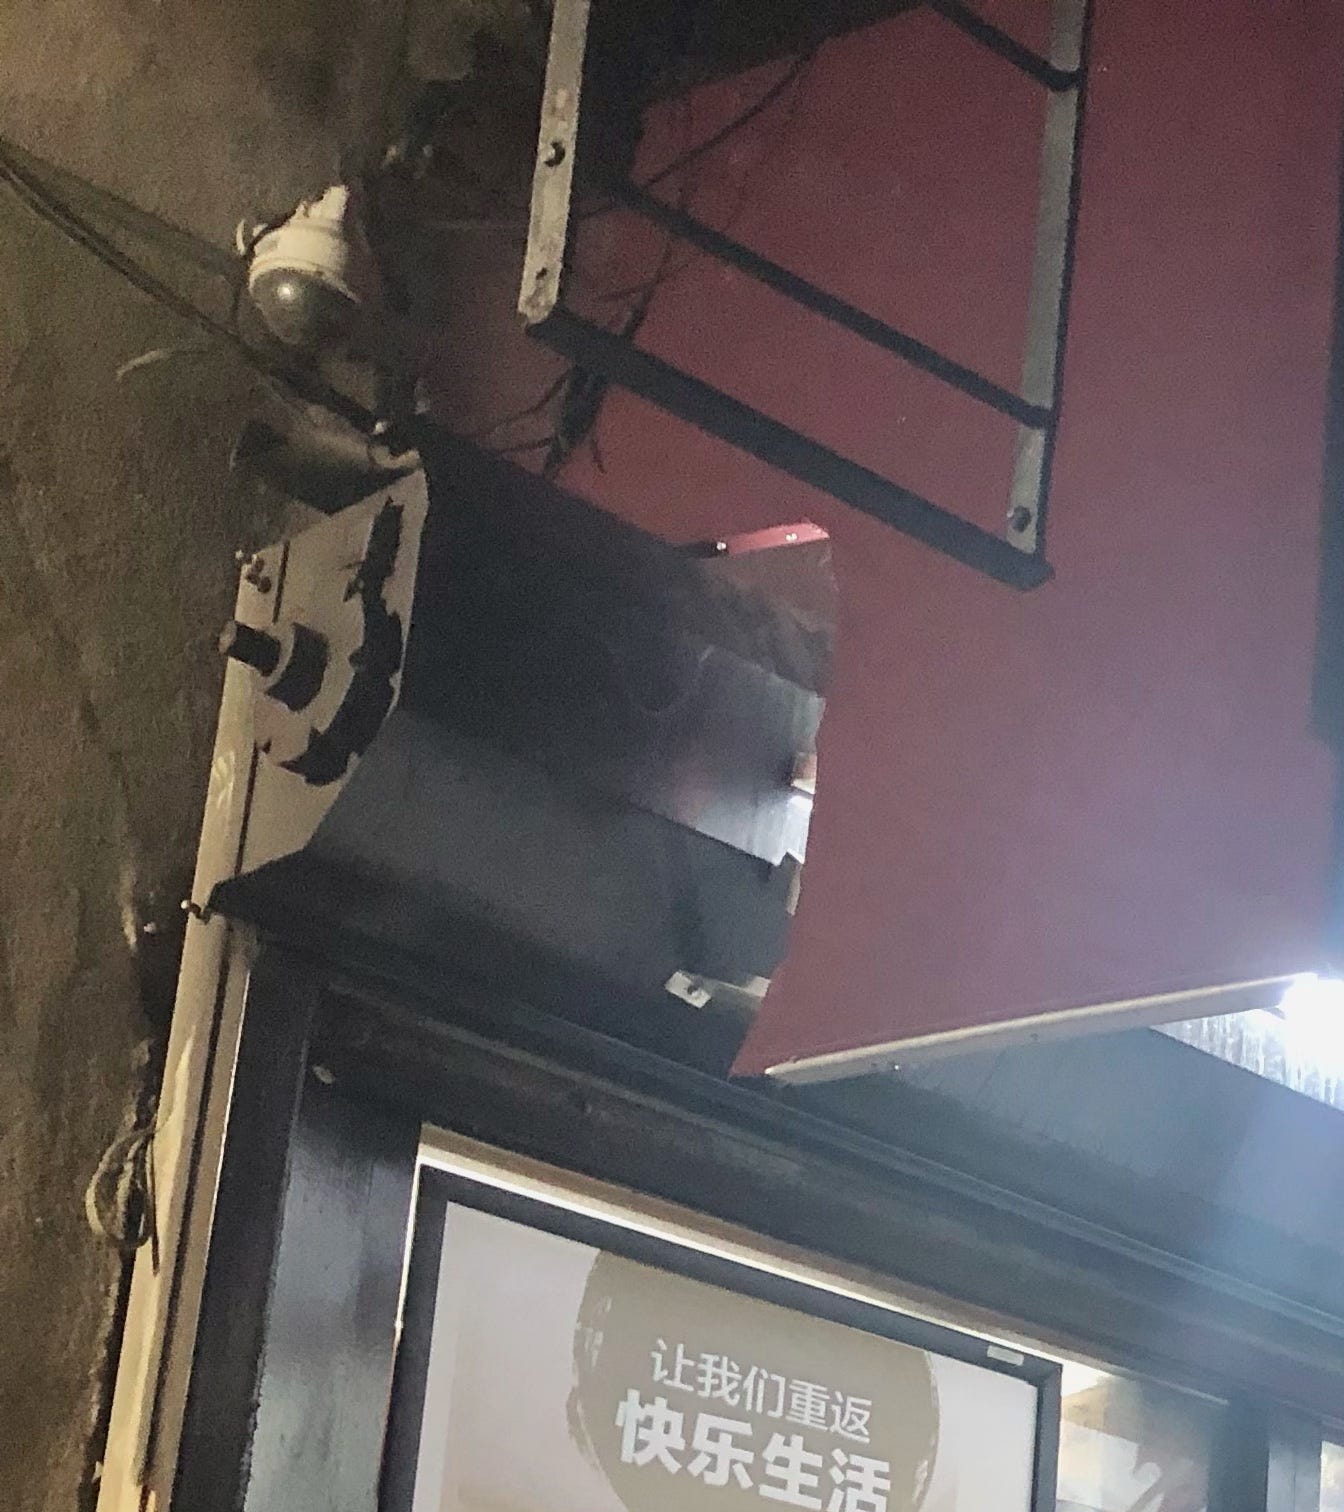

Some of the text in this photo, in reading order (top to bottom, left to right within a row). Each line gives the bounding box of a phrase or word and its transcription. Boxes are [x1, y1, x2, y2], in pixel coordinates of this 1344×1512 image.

[650, 1338, 872, 1444] 让我们重返
